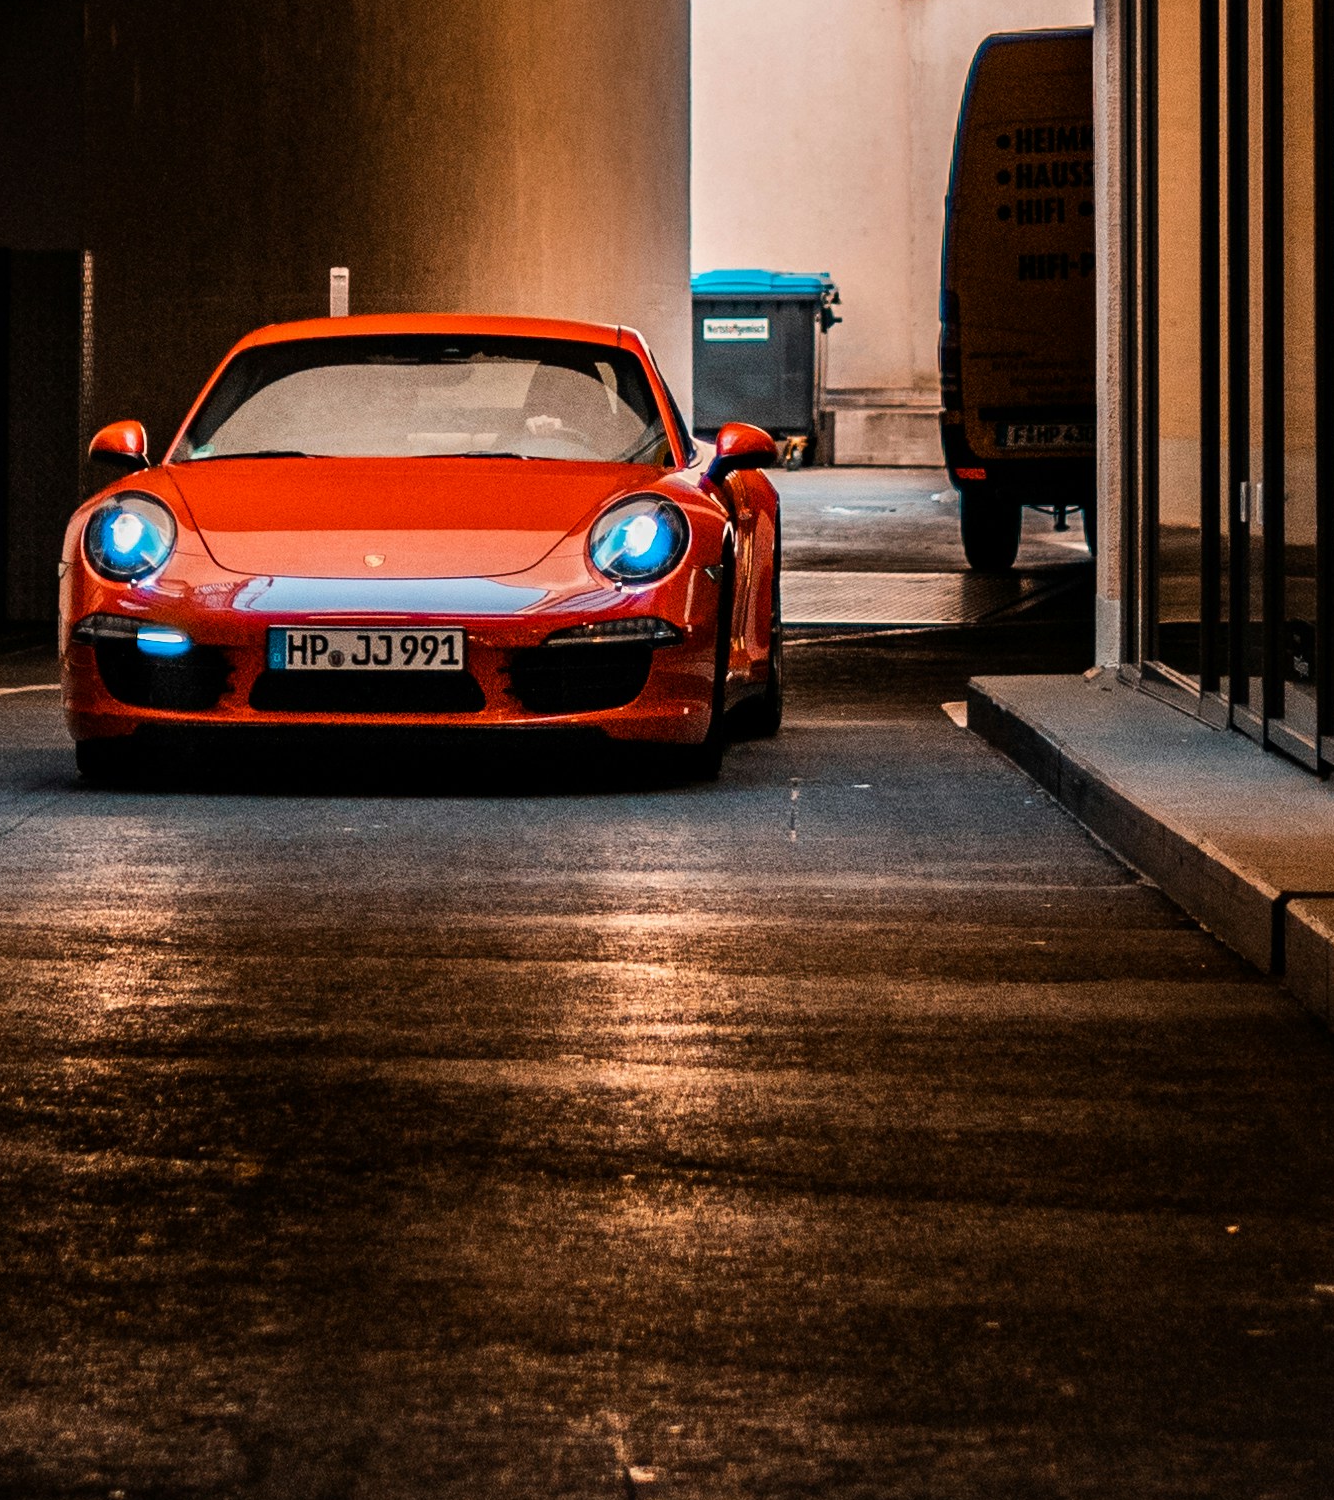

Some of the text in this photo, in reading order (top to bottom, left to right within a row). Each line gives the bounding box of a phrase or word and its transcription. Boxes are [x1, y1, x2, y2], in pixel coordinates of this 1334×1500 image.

[1017, 198, 1065, 225] HIFI
[287, 634, 460, 666] HP JJ 991
